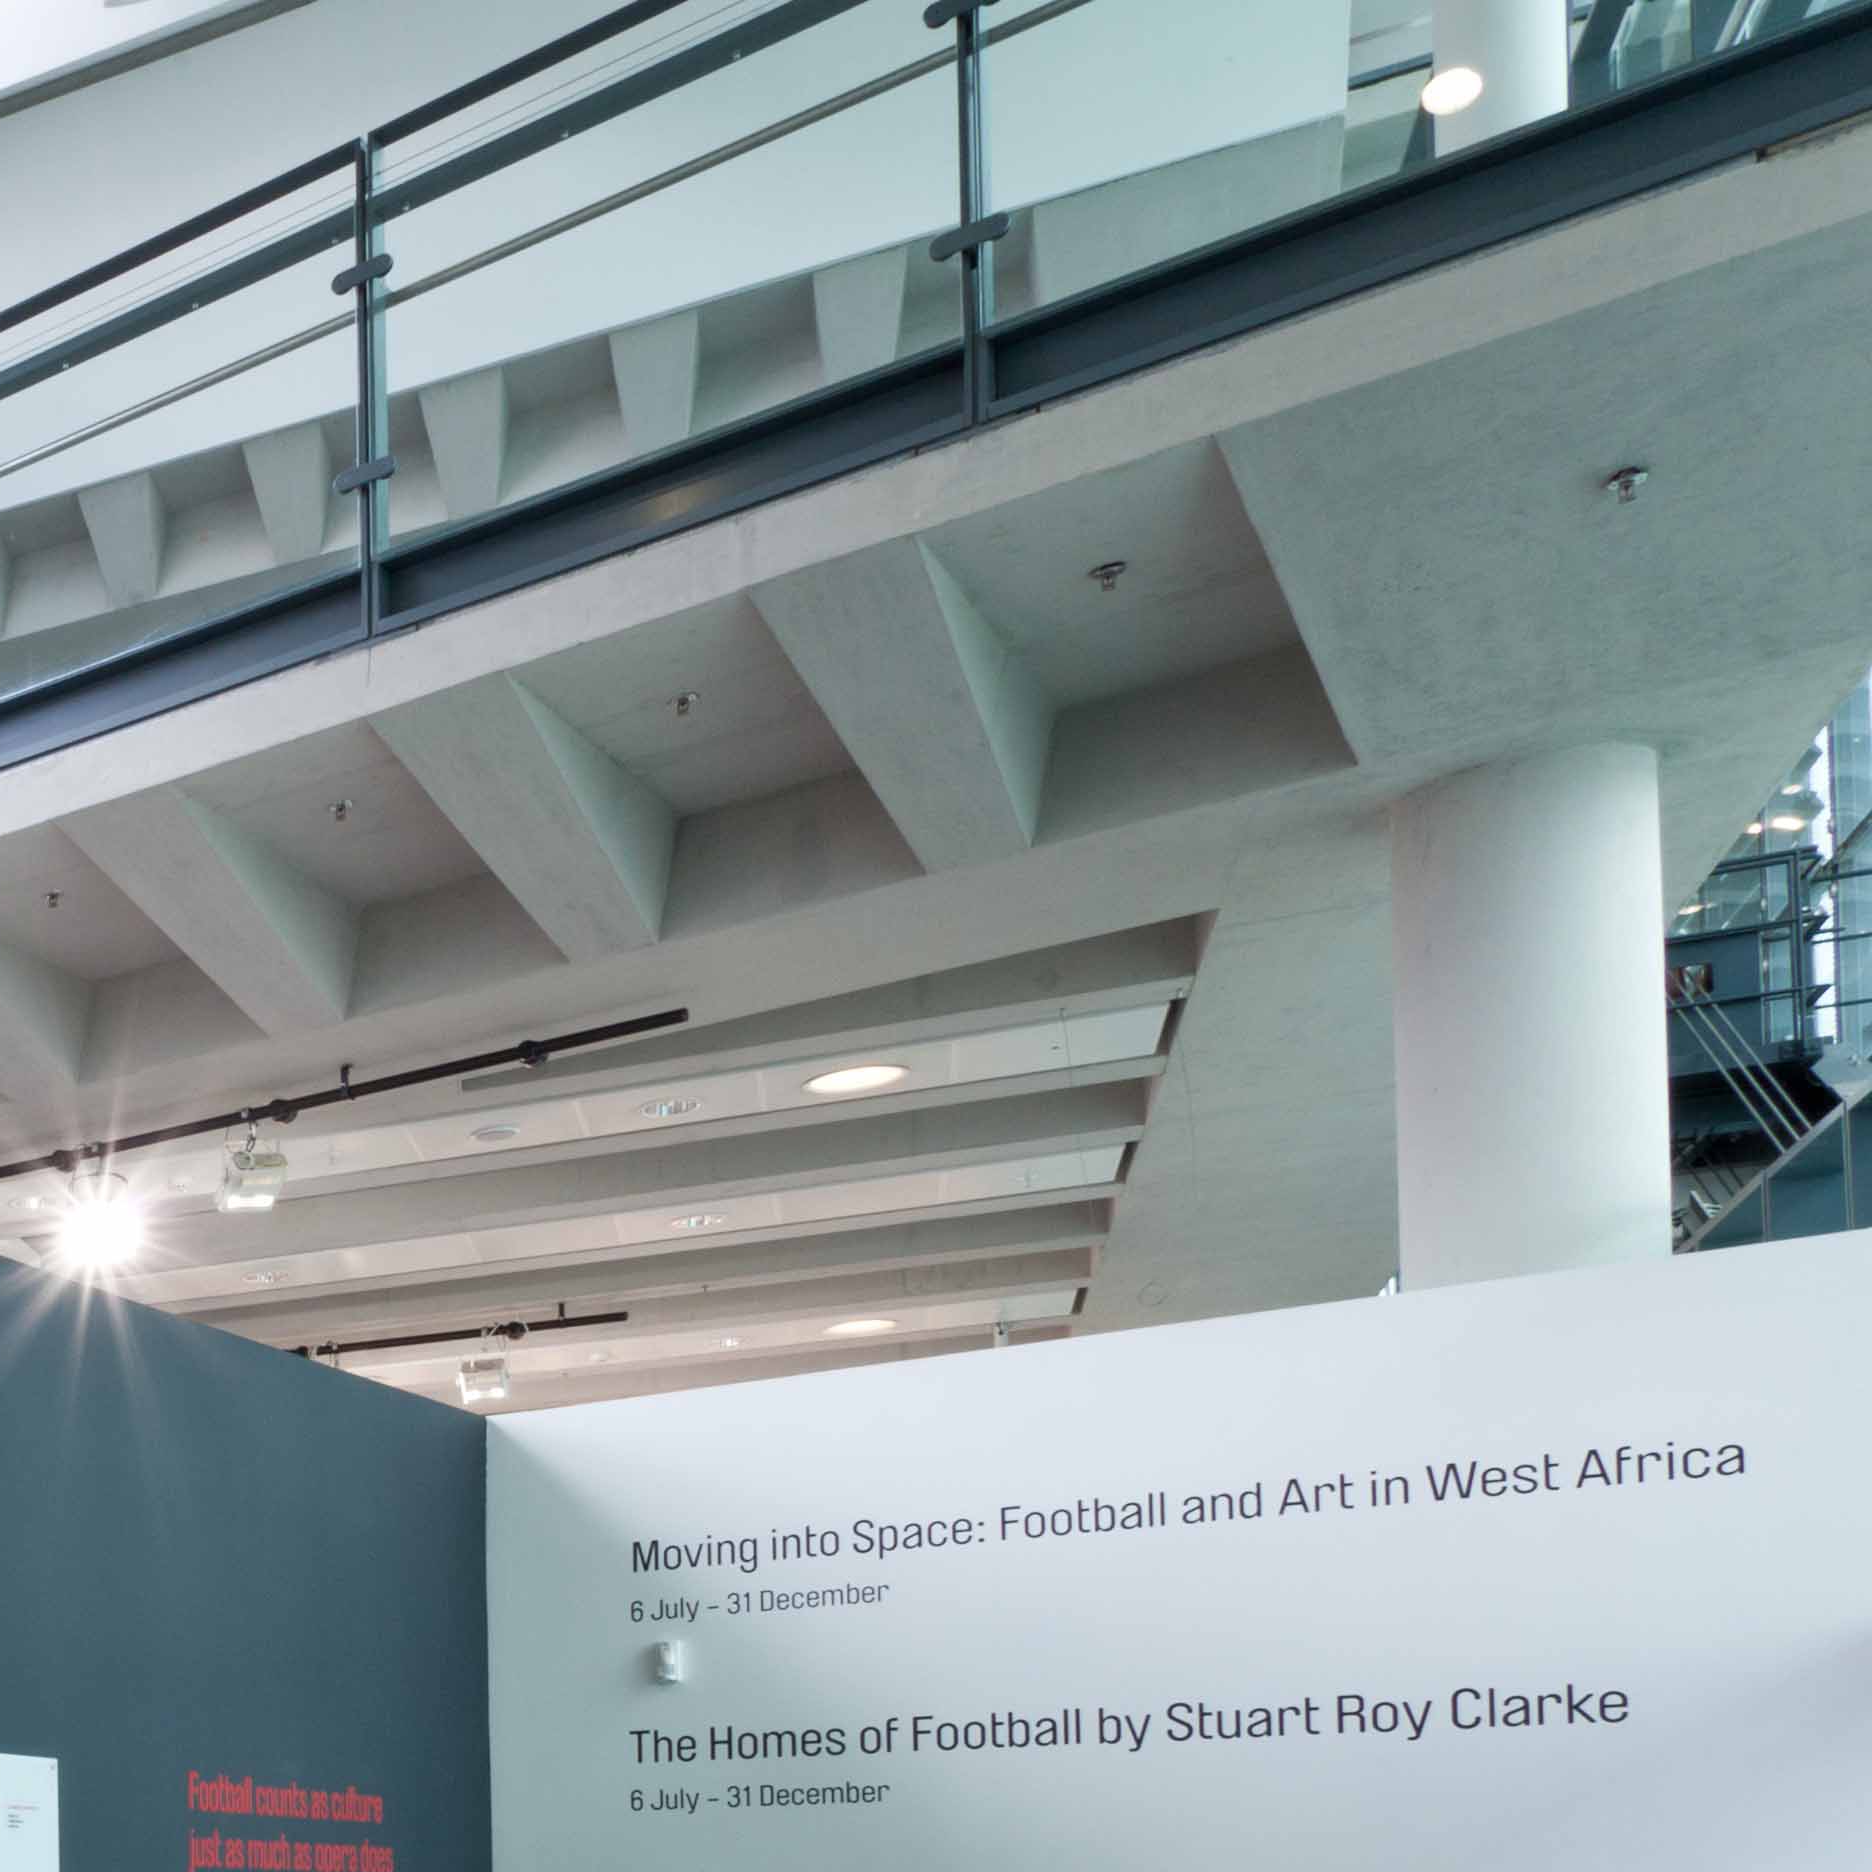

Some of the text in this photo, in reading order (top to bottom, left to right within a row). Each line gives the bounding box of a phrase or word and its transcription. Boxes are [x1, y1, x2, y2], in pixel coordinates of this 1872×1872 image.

[632, 1441, 1745, 1574] Moving into Space: Football and Art in West Africa
[630, 1600, 644, 1623] 6
[650, 1597, 700, 1623] July
[727, 1591, 751, 1615] 31
[759, 1583, 890, 1612] December
[628, 1683, 1629, 1764] The Homes of Football by Stuart Roy Clarke
[187, 1770, 383, 1824] Football counts as culture
[630, 1789, 644, 1812] 6
[650, 1788, 700, 1815] July
[727, 1785, 751, 1809] 31
[759, 1781, 891, 1807] December
[225, 1838, 244, 1869] as
[248, 1832, 291, 1870] much
[294, 1841, 311, 1871] as
